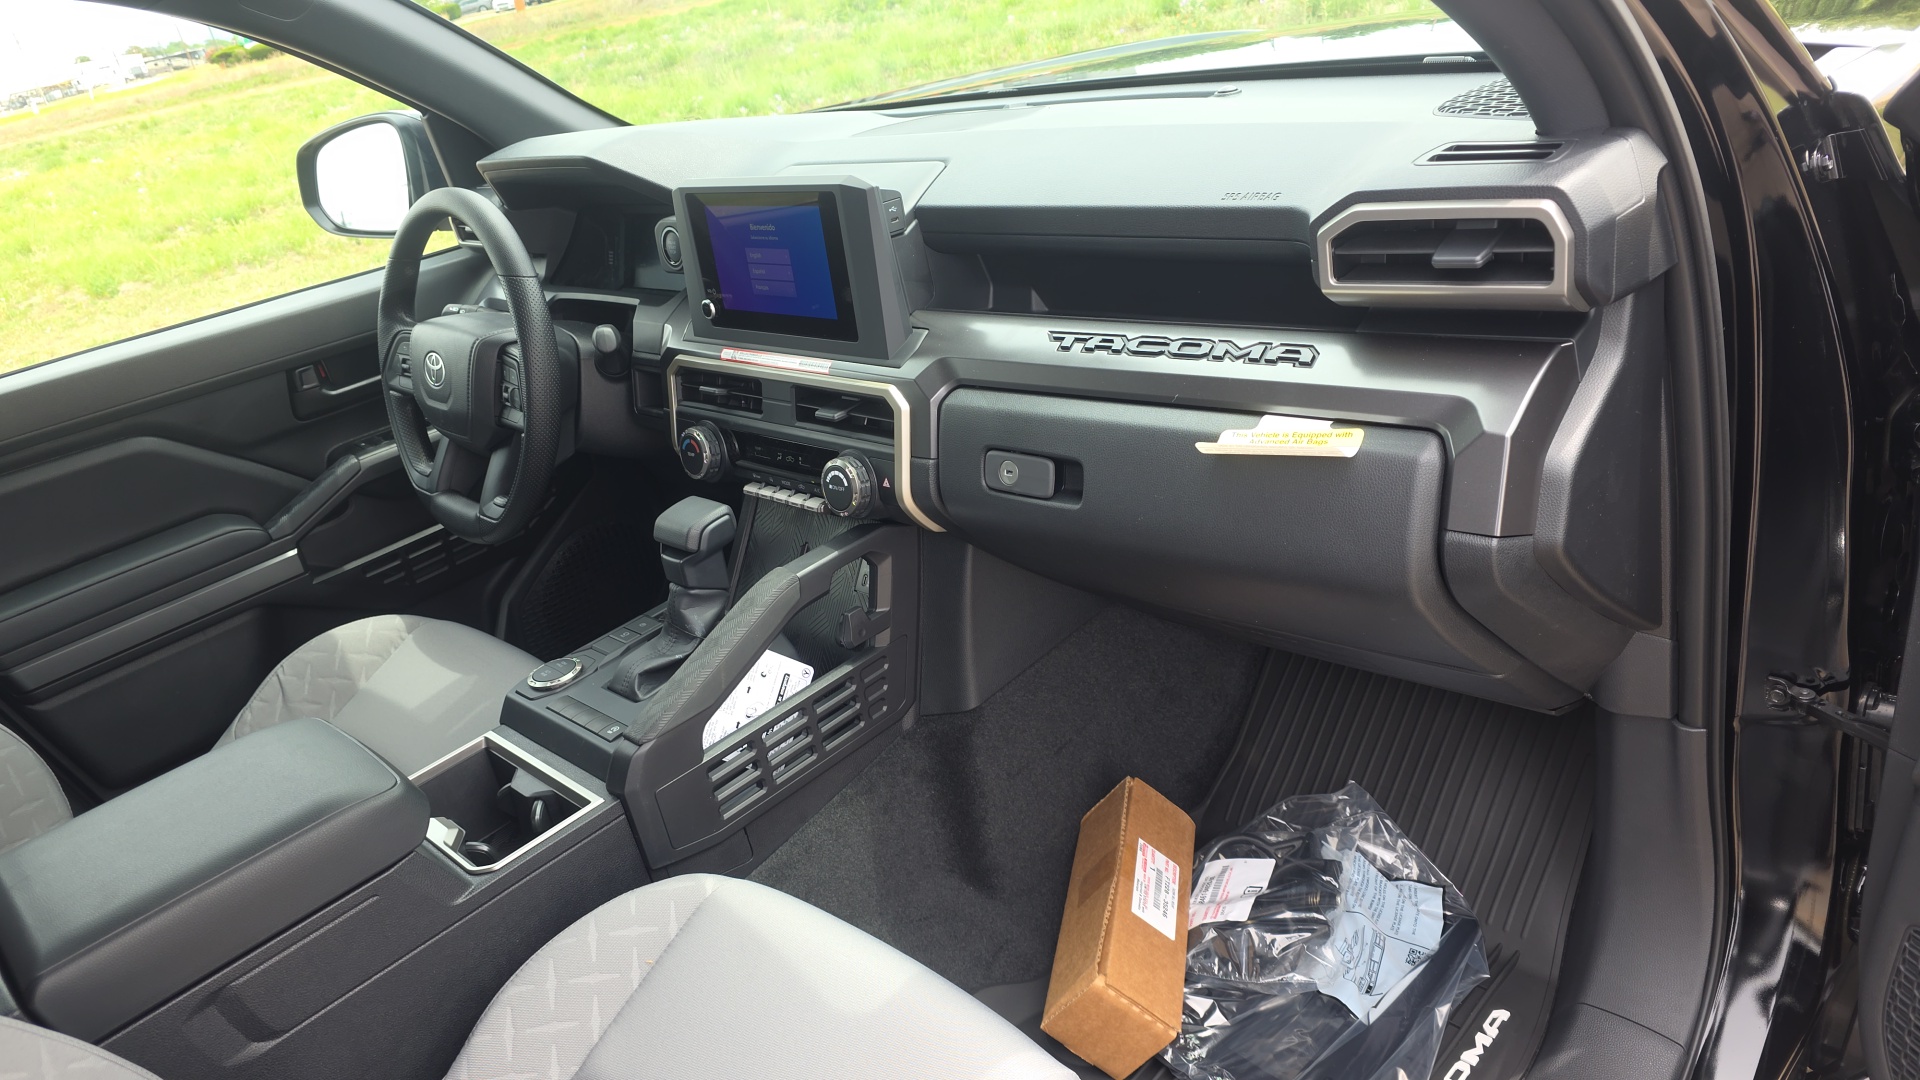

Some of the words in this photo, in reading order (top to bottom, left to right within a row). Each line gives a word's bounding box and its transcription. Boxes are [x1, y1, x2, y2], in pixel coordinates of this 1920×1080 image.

[1240, 191, 1282, 201] AIRBAG
[1048, 330, 1321, 369] TACOMA
[1291, 431, 1333, 439] Equipped
[1306, 438, 1329, 446] Bags
